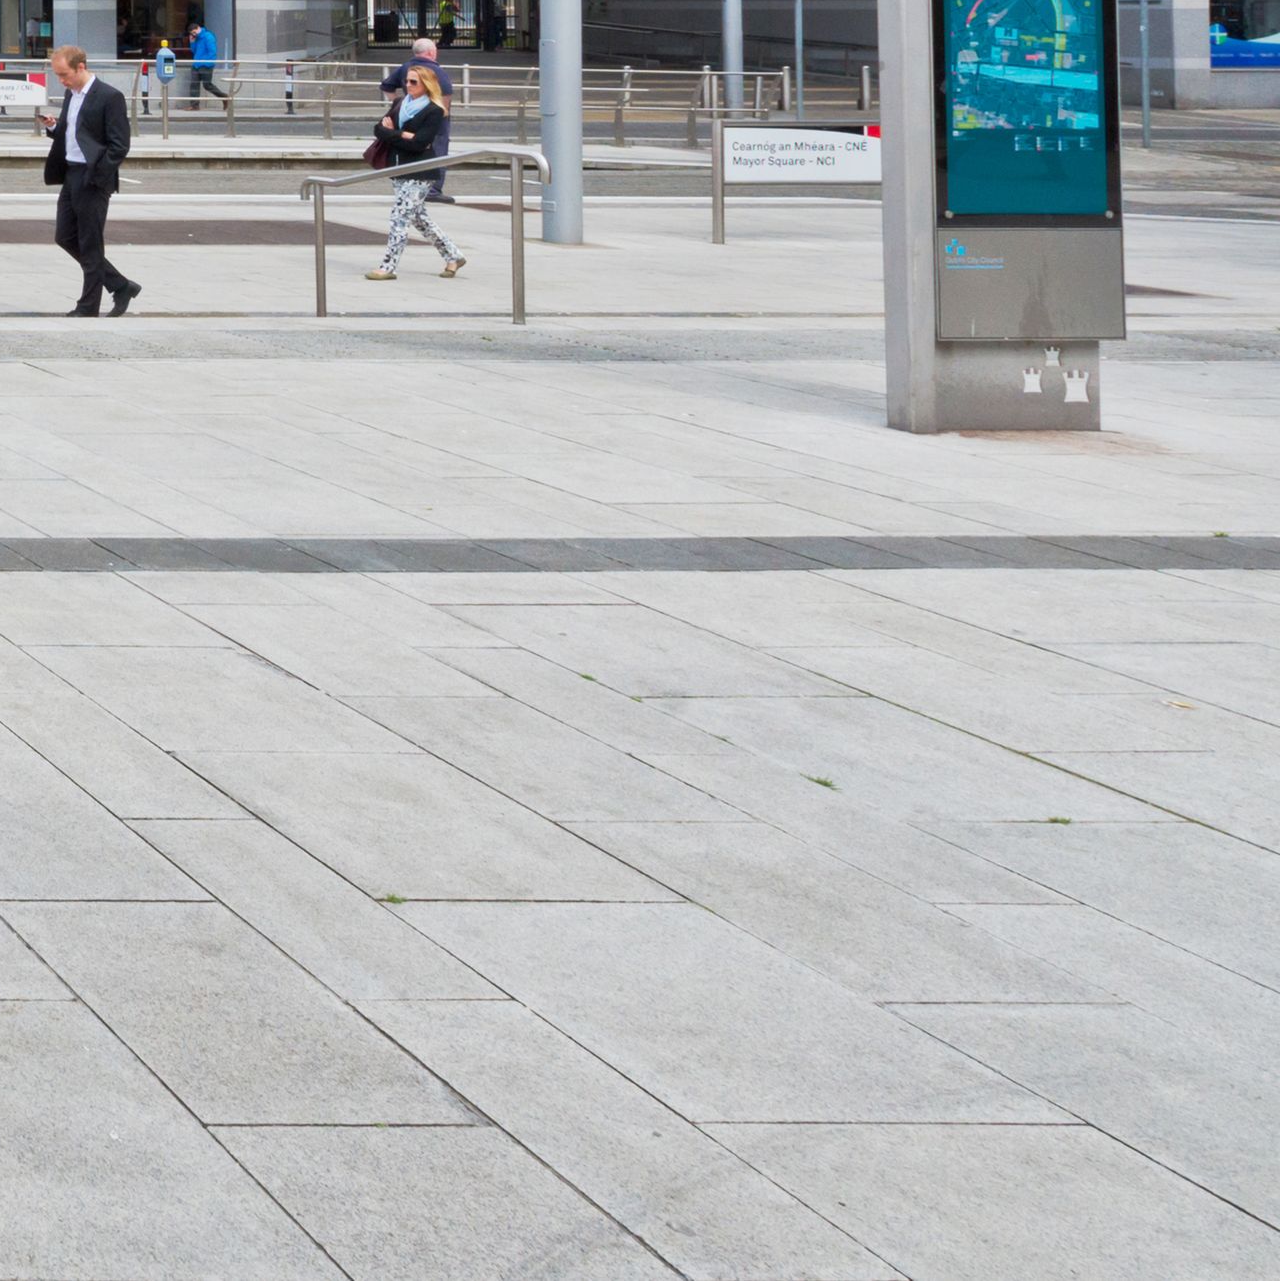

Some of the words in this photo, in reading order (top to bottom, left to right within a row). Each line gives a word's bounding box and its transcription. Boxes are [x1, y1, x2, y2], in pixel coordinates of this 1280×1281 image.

[732, 141, 776, 154] Cearnóg
[778, 143, 792, 151] an
[794, 141, 835, 151] Mhéara
[845, 139, 868, 151] CNÉ
[732, 156, 765, 168] Mayor
[768, 156, 806, 168] Square
[816, 156, 835, 165] NCI
